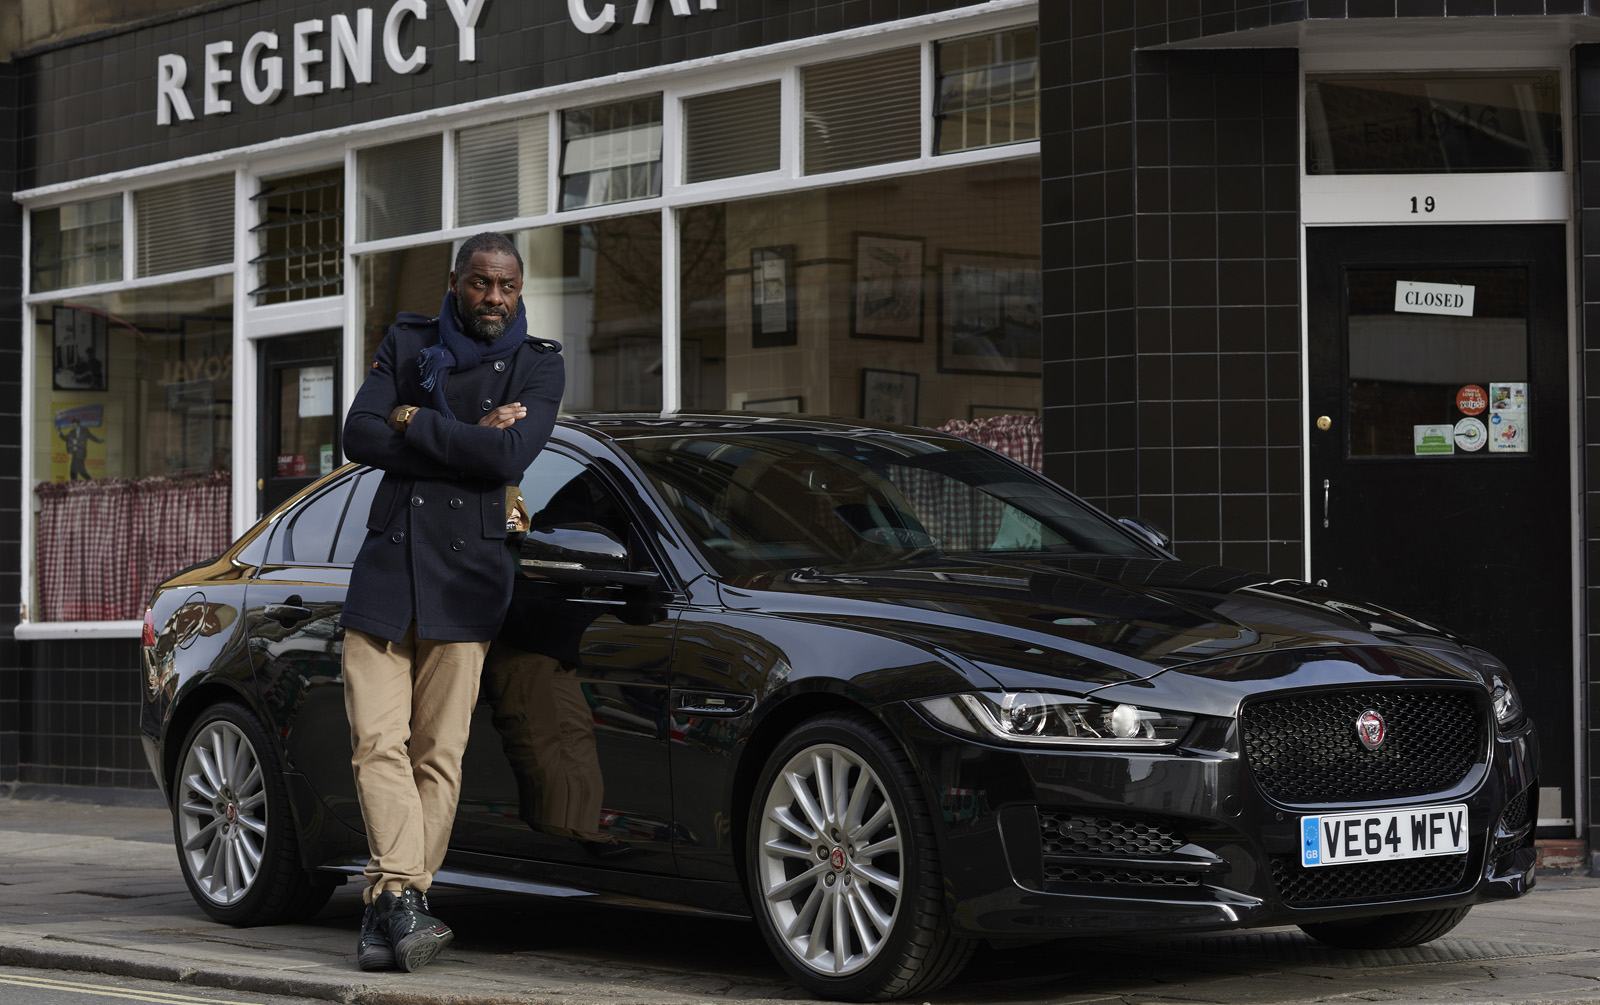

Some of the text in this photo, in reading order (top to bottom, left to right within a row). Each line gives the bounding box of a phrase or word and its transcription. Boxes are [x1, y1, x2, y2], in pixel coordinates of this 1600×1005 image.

[157, 0, 482, 126] REGENCY
[1410, 196, 1436, 213] 19
[1404, 290, 1465, 308] CLOSED
[1324, 811, 1463, 858] VE64 WFV
[1306, 850, 1318, 859] GB
